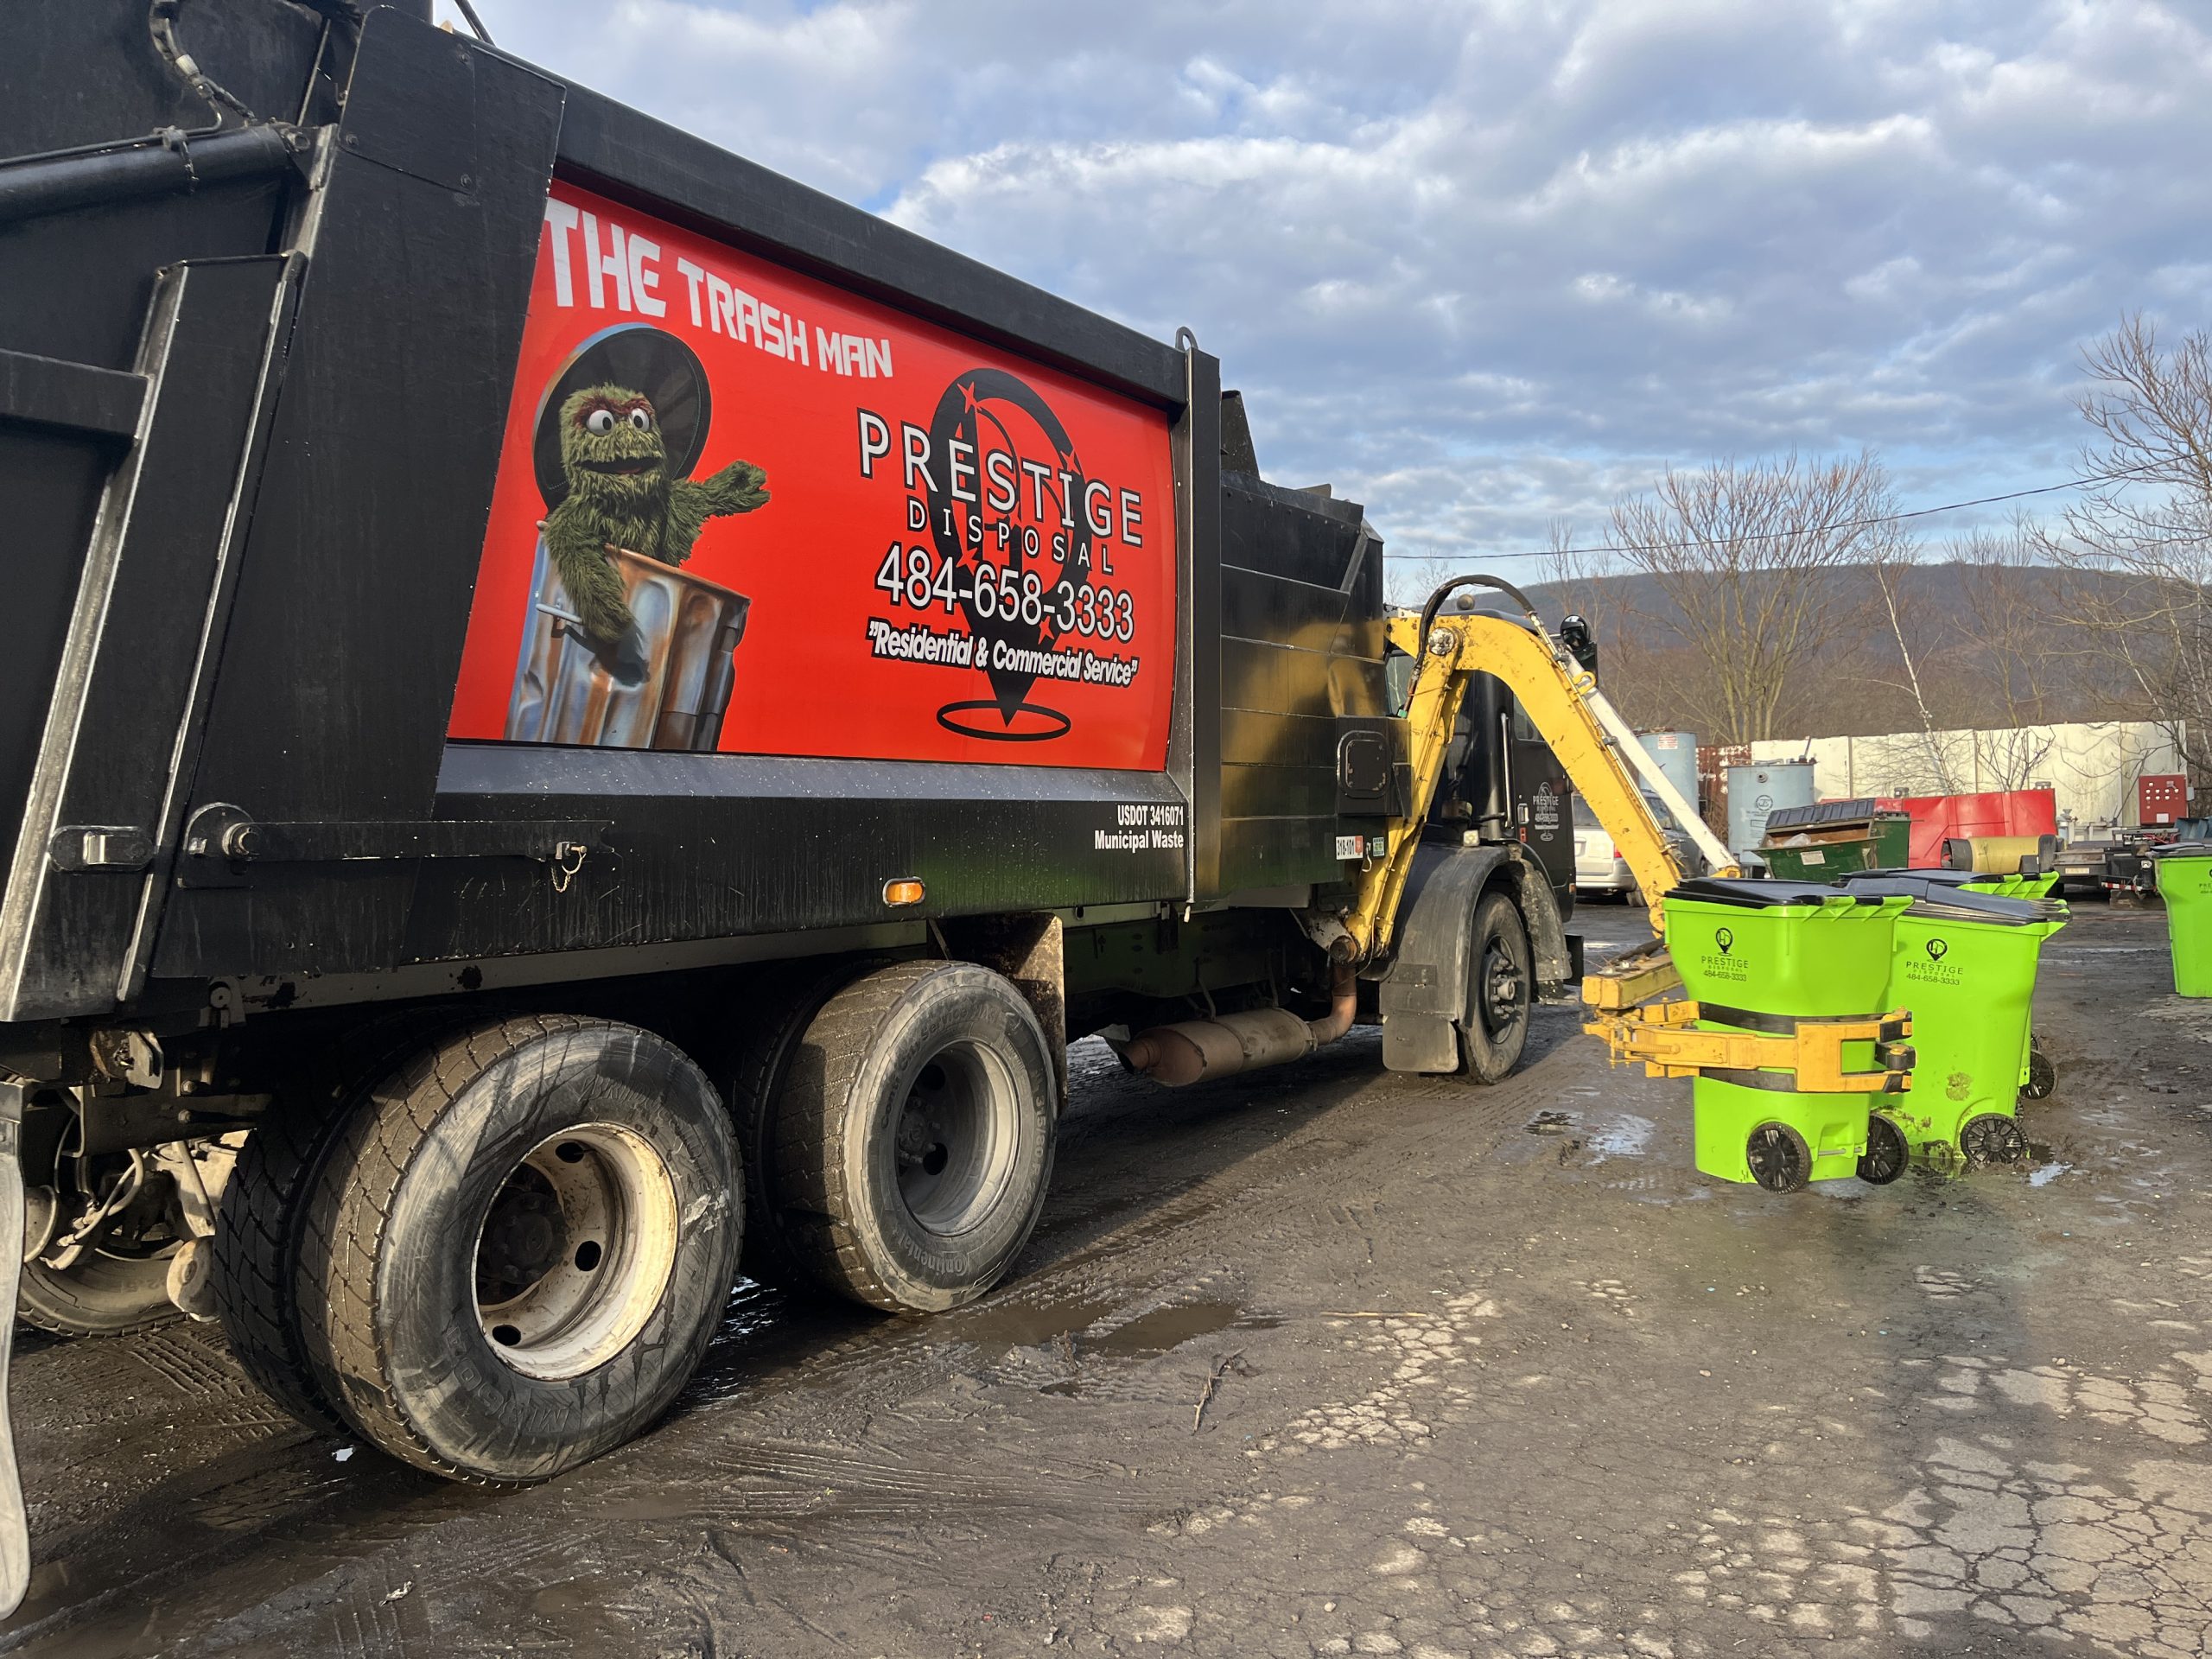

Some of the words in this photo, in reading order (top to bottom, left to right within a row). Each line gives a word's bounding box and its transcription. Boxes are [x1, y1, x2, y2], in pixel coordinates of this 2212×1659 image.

[544, 197, 666, 318] THE
[677, 257, 810, 366] TRASH
[816, 327, 893, 378] MAN
[859, 410, 1142, 546] PRESTIGE
[908, 498, 1113, 574] DISPOSAL
[875, 543, 1134, 642] 484-658-3333
[975, 637, 989, 668] &
[993, 639, 1082, 680] Commercial
[1117, 804, 1148, 826] USDOT
[1150, 805, 1184, 826] 3416071
[1094, 830, 1149, 854] Municipal
[1151, 830, 1185, 849] Waste
[1701, 956, 1749, 969] PRESTIGE
[1906, 961, 1964, 975] PRESTIGE
[1906, 973, 1960, 986] 484-658-3333
